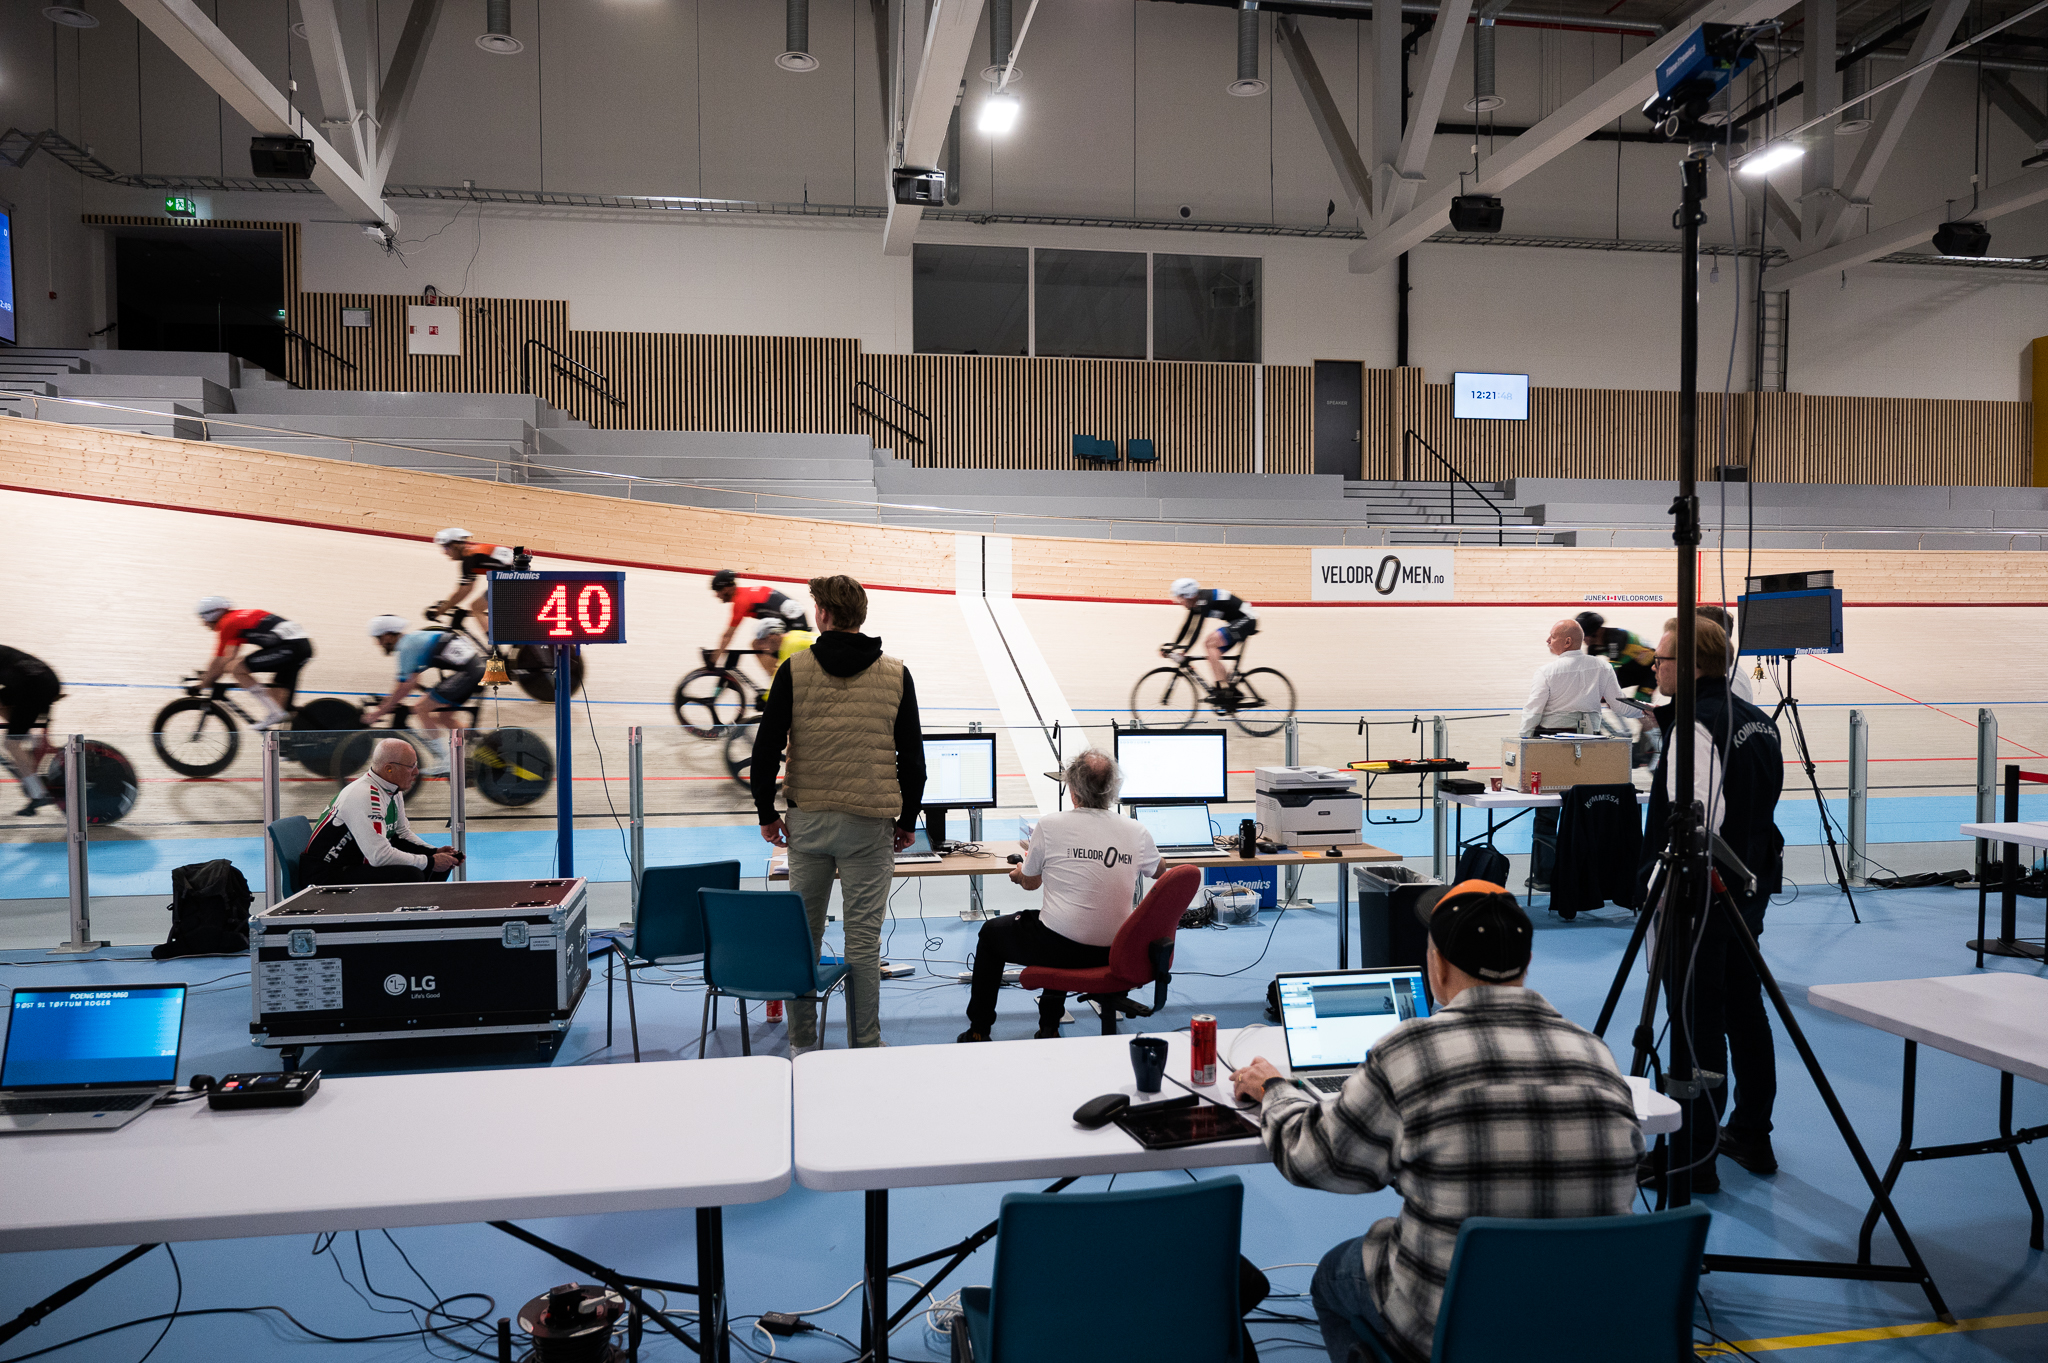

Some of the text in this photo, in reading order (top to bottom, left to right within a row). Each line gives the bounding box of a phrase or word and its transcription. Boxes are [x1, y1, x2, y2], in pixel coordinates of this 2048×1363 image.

[496, 571, 540, 580] TimeTronics
[537, 585, 611, 636] 40
[1073, 846, 1133, 868] VELODROMEN
[411, 975, 436, 991] LG
